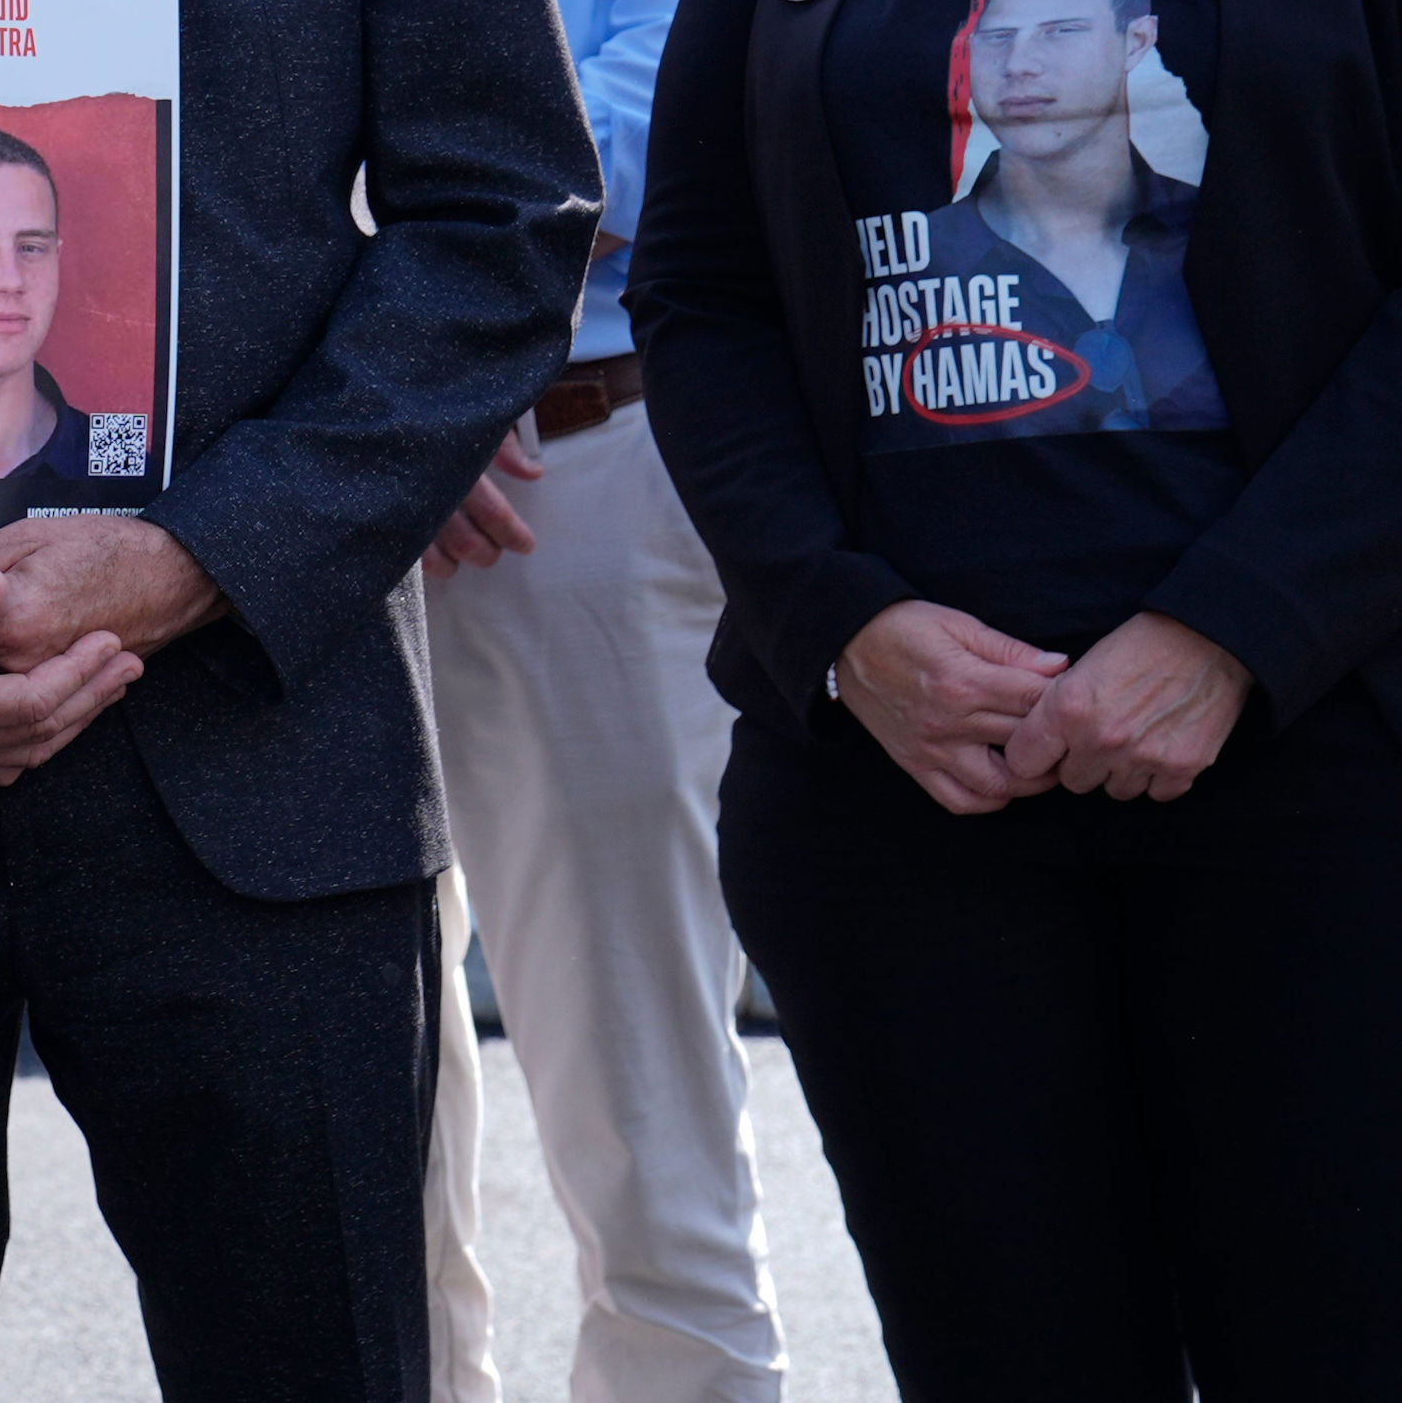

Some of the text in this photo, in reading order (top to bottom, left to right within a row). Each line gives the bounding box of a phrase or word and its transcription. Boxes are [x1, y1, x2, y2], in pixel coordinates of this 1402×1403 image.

[862, 274, 1023, 348] HOSTAGE
[863, 340, 1058, 418] BY HAMAS
